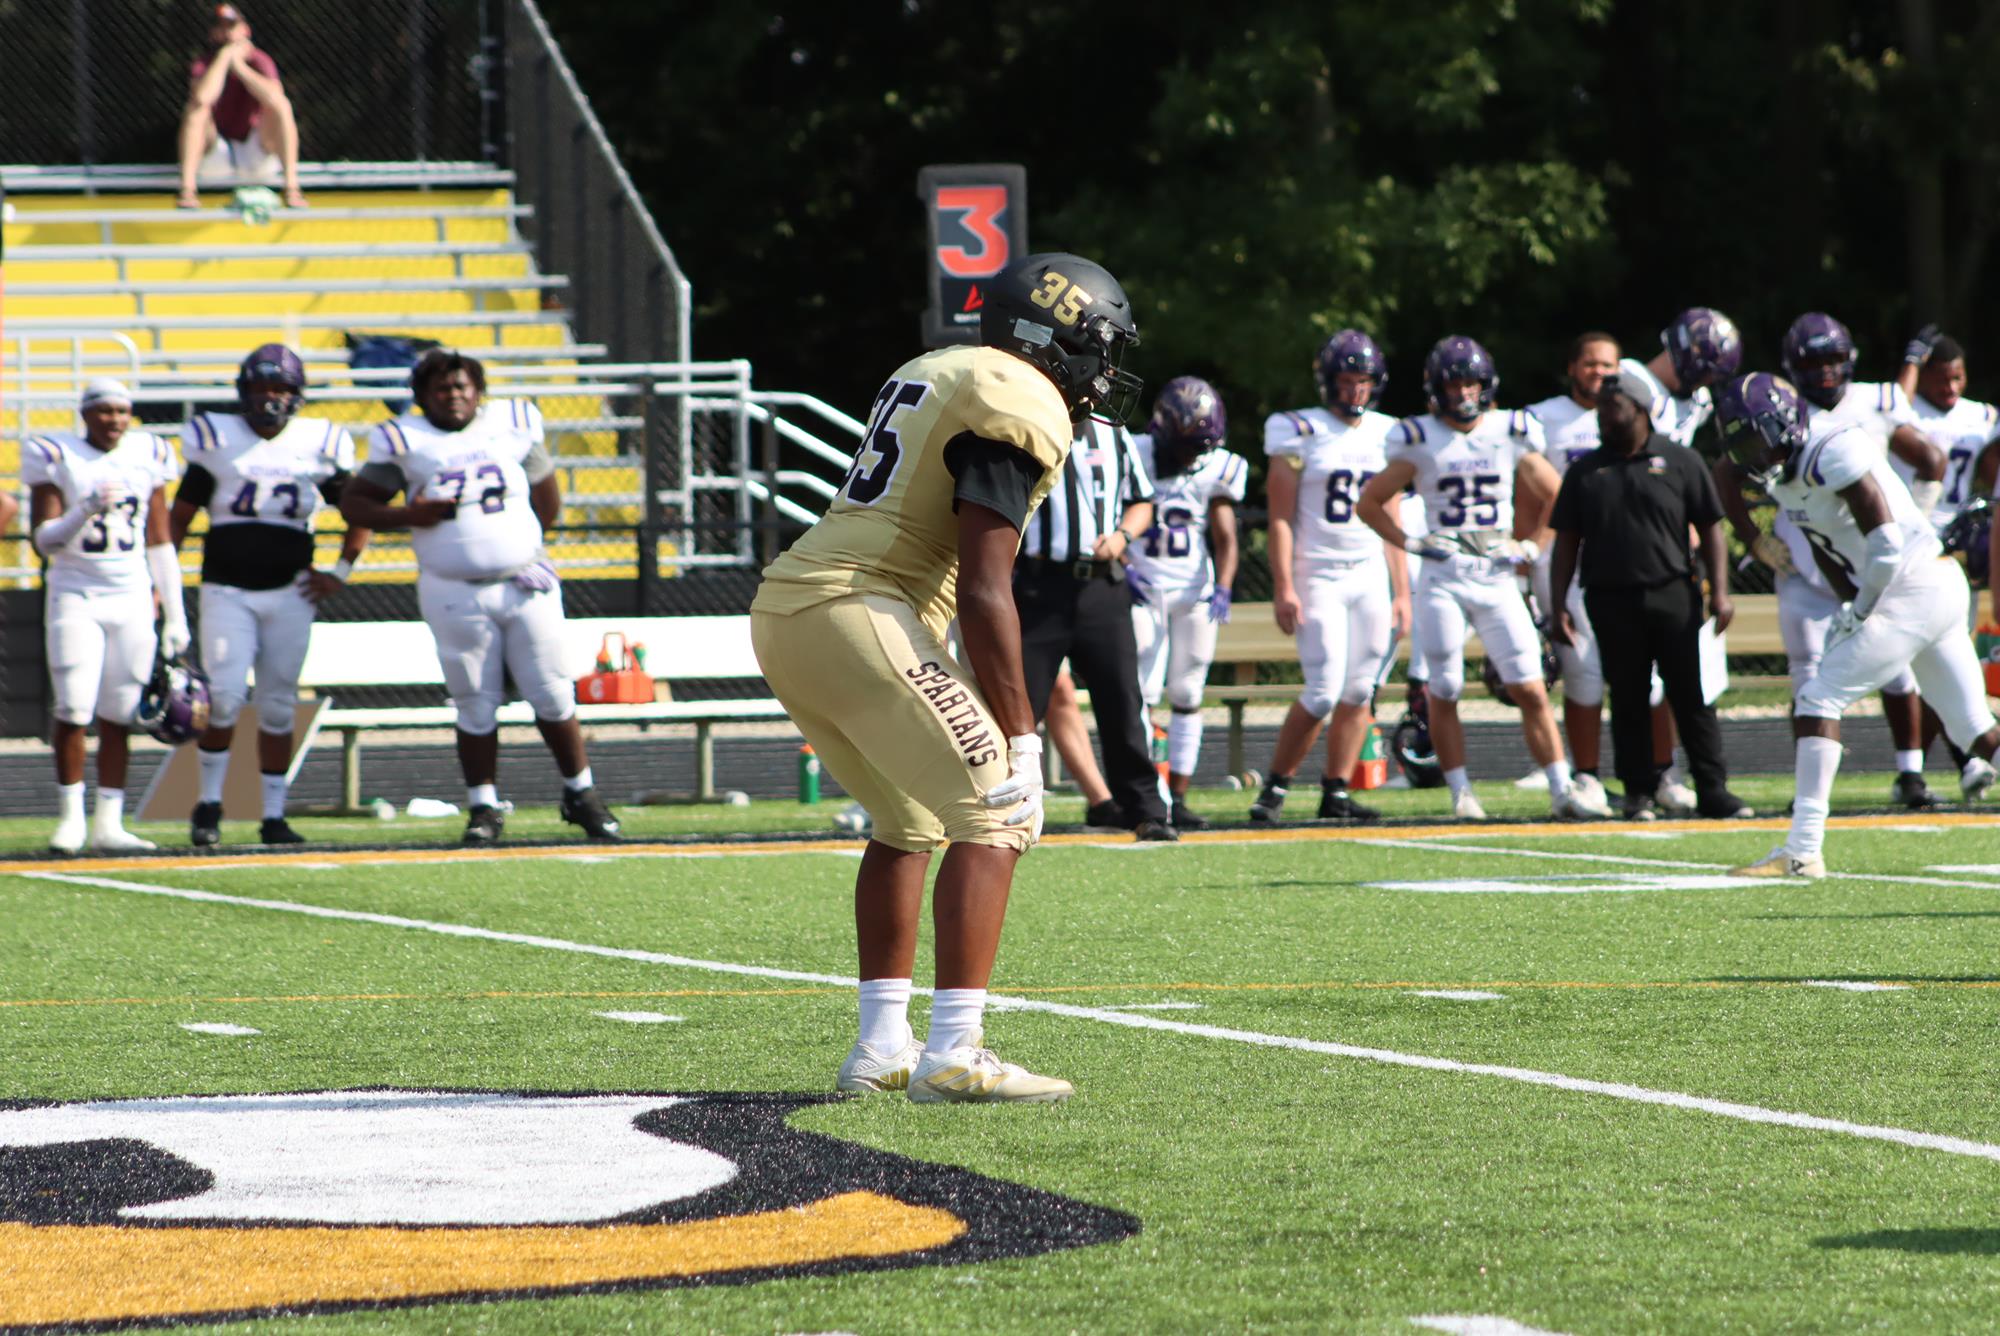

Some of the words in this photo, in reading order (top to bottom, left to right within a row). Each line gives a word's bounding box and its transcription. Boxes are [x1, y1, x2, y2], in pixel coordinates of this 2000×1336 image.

[937, 185, 1009, 278] 3
[1030, 271, 1094, 326] 35
[834, 378, 934, 506] 35
[1438, 474, 1501, 527] 35
[905, 660, 999, 769] SPARTANS
